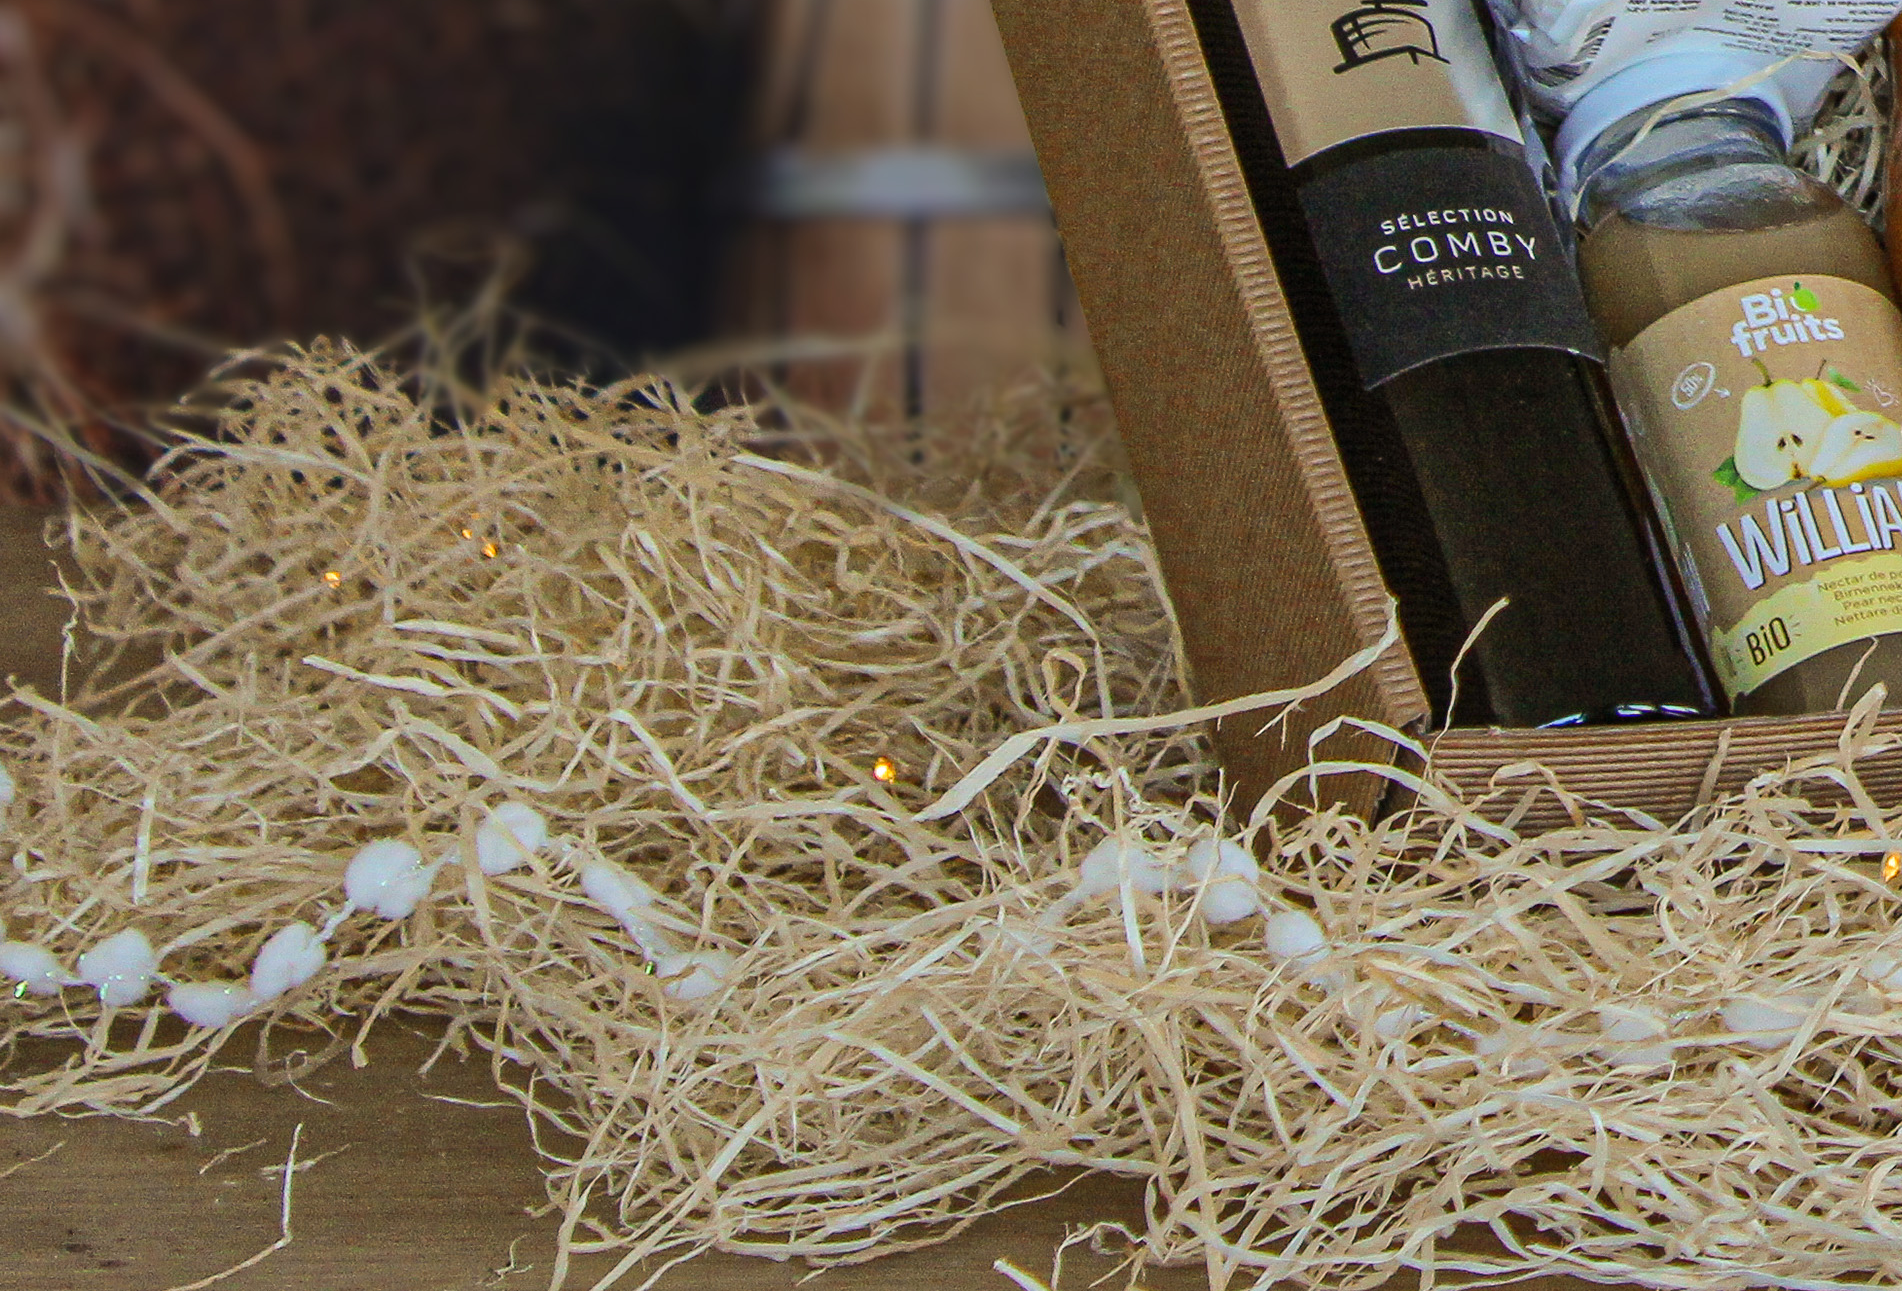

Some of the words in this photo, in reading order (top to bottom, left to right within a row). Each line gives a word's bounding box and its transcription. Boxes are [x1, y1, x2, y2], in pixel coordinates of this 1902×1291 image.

[1380, 208, 1517, 236] SÉLECTION
[1373, 230, 1537, 275] COMBY
[1406, 265, 1526, 291] HÉRITAGE
[1730, 313, 1846, 359] fruits
[1817, 572, 1866, 594] Nectar
[1867, 569, 1887, 582] de
[1843, 596, 1875, 612] Pear
[1833, 609, 1889, 628] Nettare
